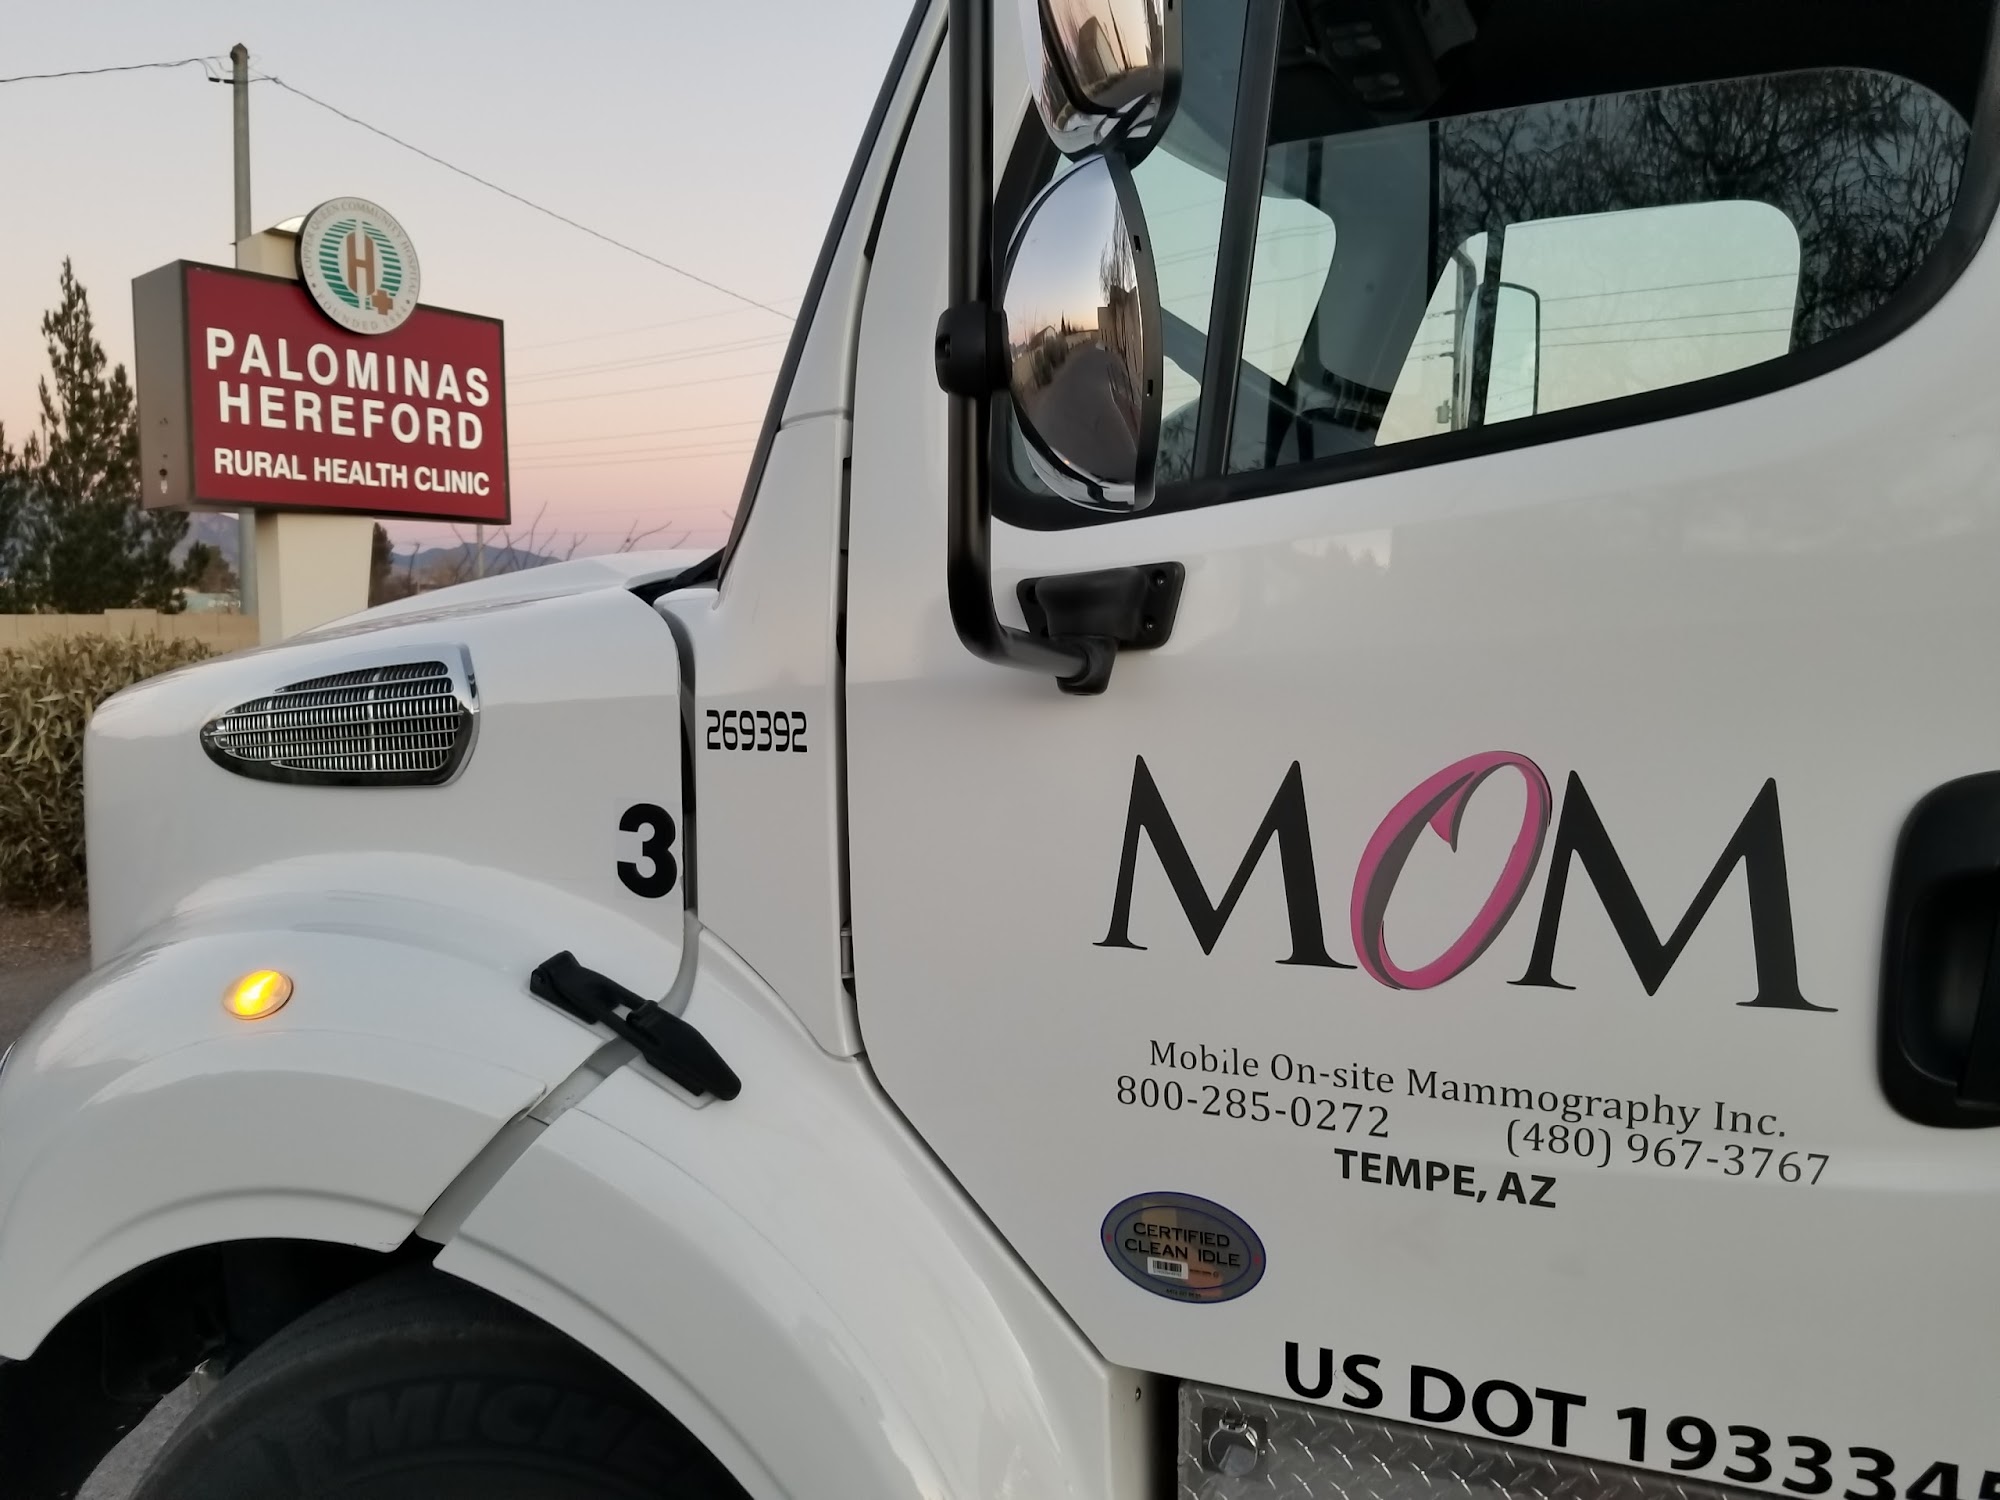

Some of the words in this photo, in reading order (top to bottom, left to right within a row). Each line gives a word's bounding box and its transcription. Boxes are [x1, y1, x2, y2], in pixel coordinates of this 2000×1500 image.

[303, 231, 314, 278] COPPER
[311, 204, 340, 230] QUEEN
[341, 201, 402, 238] COMMUNITY
[401, 241, 418, 295] HOSPITAL
[315, 292, 375, 331] FOUNDED
[206, 327, 490, 407] PALOMINAS
[218, 381, 483, 450] HEREFORD
[214, 447, 307, 481] RURAL
[313, 456, 408, 489] HEALTH
[414, 466, 490, 496] CLINIC
[706, 709, 808, 753] 269392
[617, 803, 678, 899] 3
[1092, 750, 1839, 1013] MOM
[1116, 1075, 1389, 1138] 800-285-0272
[1150, 1040, 1259, 1077] Mobile
[1271, 1053, 1395, 1093] On-site
[1407, 1068, 1701, 1135] Mammography
[1713, 1101, 1786, 1137] Inc.
[1334, 1148, 1488, 1203] TEMPE,
[1497, 1171, 1557, 1209] AZ
[1507, 1119, 1611, 1168] (480)
[1627, 1133, 1830, 1186] 967-3767
[1124, 1238, 1188, 1260] CLEAN
[1198, 1249, 1241, 1267] IDLE
[1133, 1222, 1230, 1248] CERTIFIED
[1284, 1340, 1384, 1409] US
[1410, 1364, 1587, 1448] DOT
